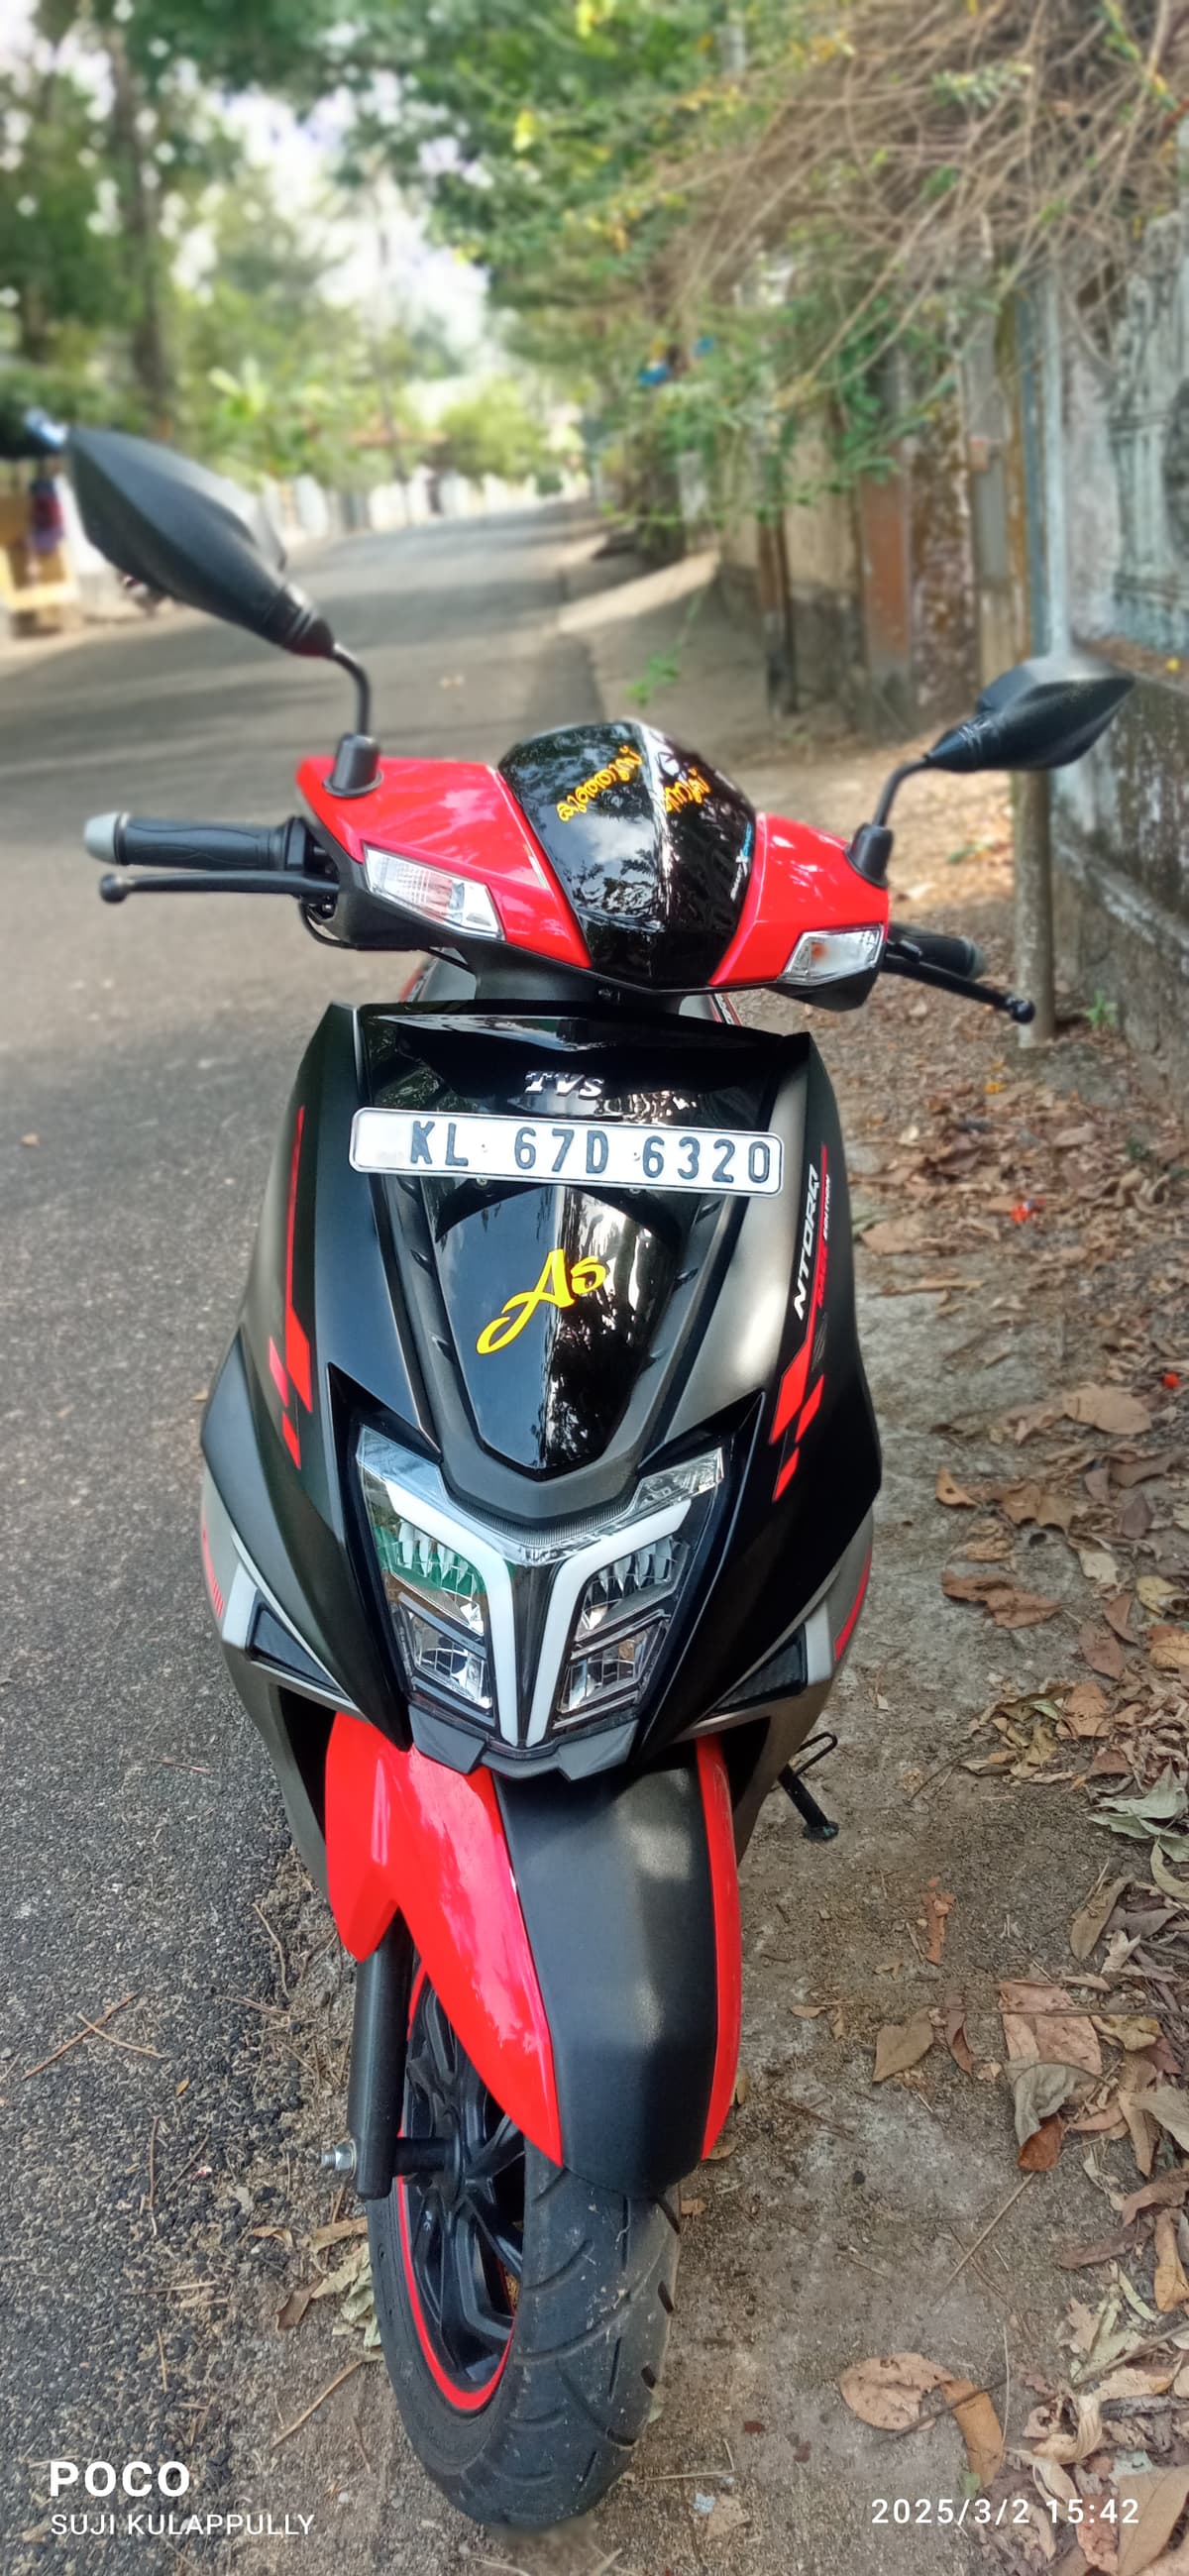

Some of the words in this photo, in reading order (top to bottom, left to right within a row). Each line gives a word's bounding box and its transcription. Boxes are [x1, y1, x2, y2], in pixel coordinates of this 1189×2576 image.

[524, 1070, 605, 1099] TVS
[409, 1120, 470, 1167] KL
[513, 1127, 609, 1175] 67D
[642, 1134, 771, 1185] 6320
[794, 1163, 820, 1321] NTORQ
[476, 1248, 607, 1356] As
